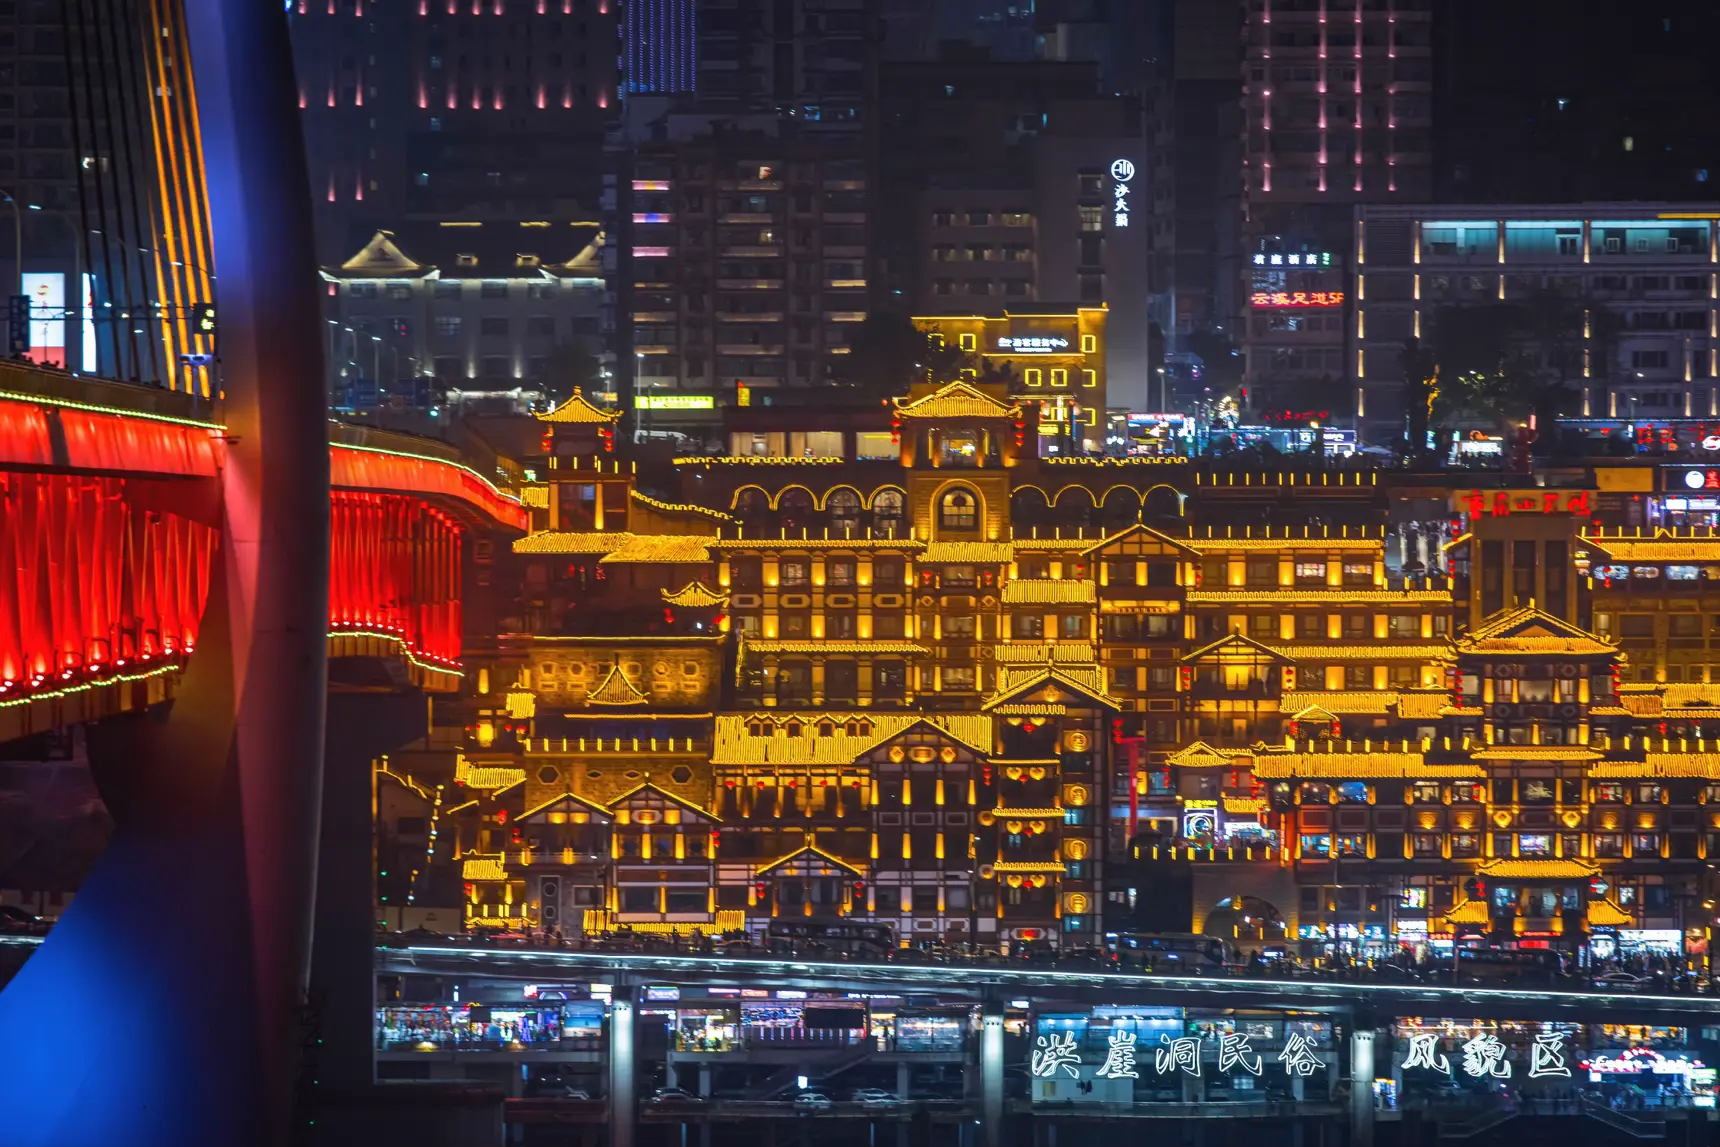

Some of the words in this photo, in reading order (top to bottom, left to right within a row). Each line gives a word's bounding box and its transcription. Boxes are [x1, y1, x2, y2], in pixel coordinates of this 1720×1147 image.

[1031, 1030, 1326, 1080] 洪崖洞民俗
[1401, 1032, 1572, 1079] 风貌区
